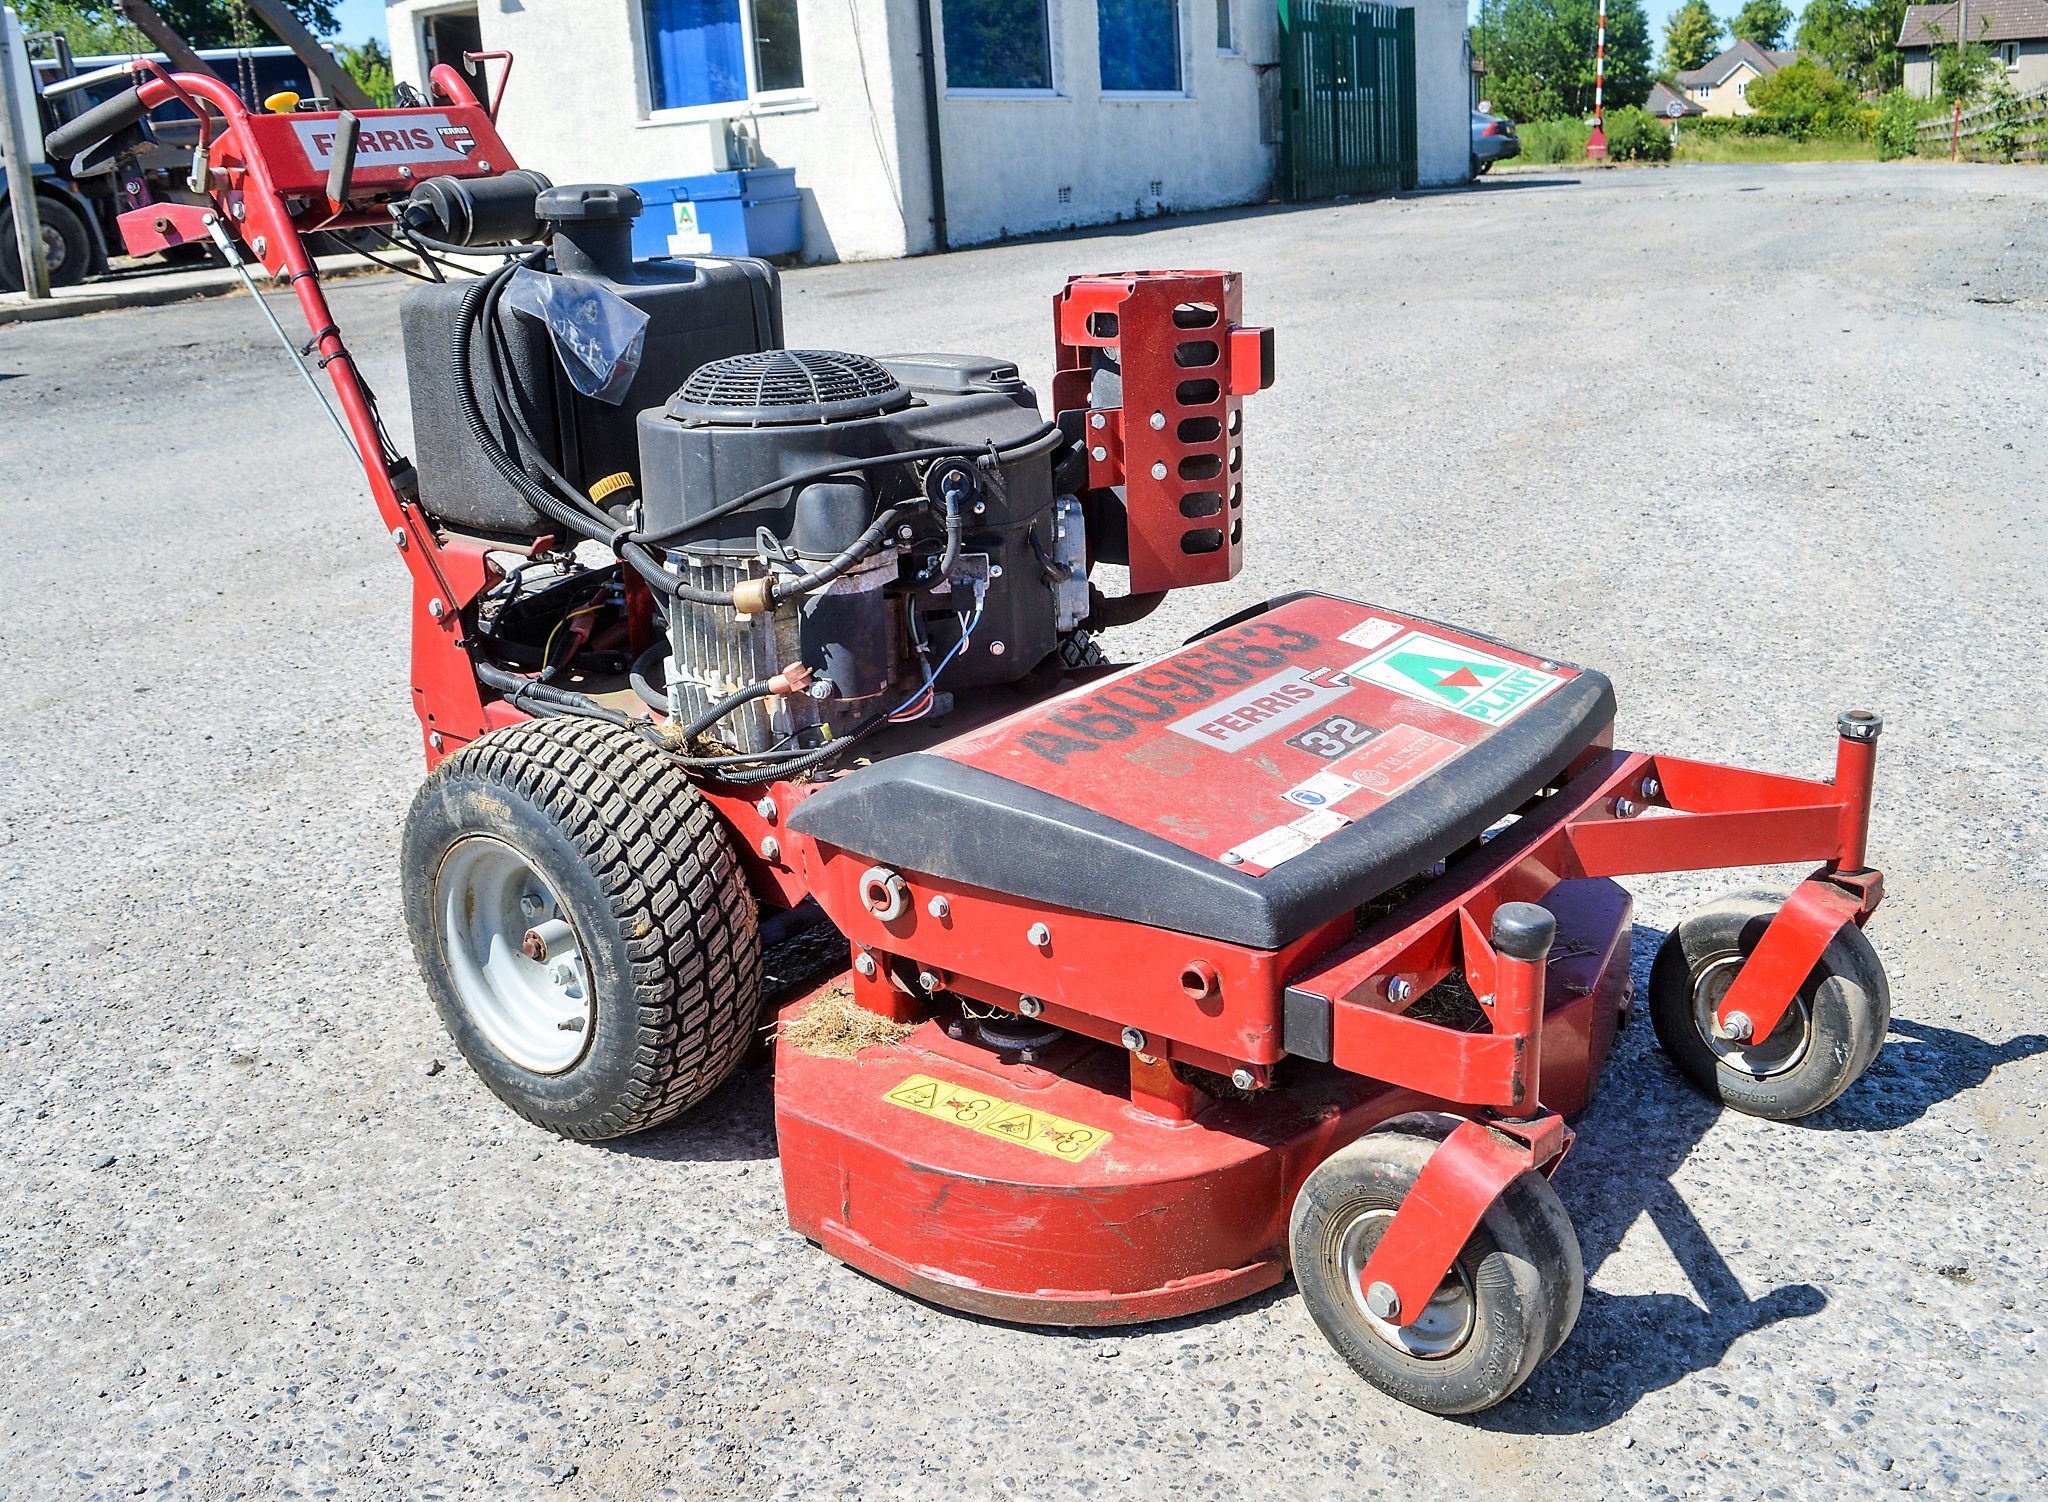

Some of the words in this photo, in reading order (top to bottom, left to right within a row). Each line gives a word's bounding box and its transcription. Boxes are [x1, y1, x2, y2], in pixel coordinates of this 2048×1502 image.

[311, 128, 434, 156] FRRIS
[437, 126, 470, 136] FERRIS
[679, 206, 694, 224] A
[1017, 622, 1321, 765] A609663
[1196, 683, 1314, 742] FERRIS
[1463, 668, 1541, 720] PLANT
[1300, 717, 1374, 757] 32
